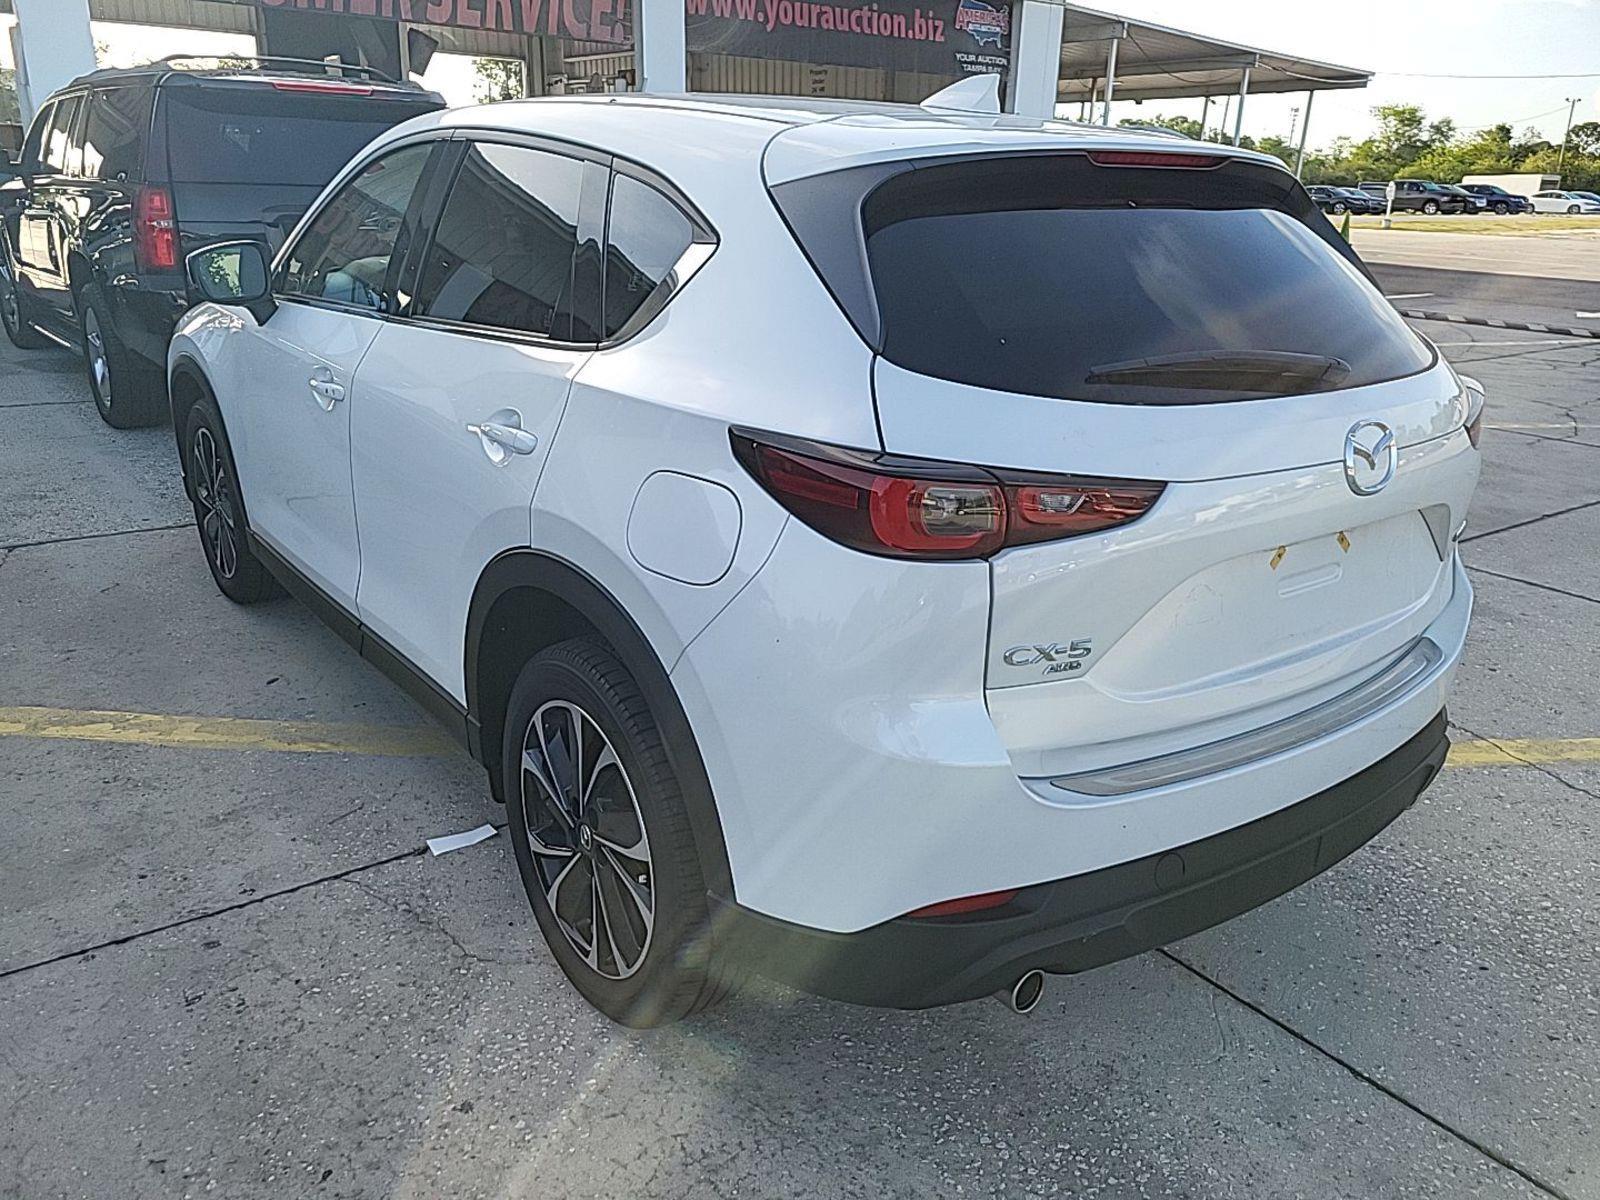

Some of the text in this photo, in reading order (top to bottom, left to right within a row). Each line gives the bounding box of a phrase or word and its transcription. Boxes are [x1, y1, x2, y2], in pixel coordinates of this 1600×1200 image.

[686, 0, 945, 42] www.yourauction.biz
[955, 53, 1008, 66] YOUR AUCTION
[1003, 638, 1092, 666] CX-5
